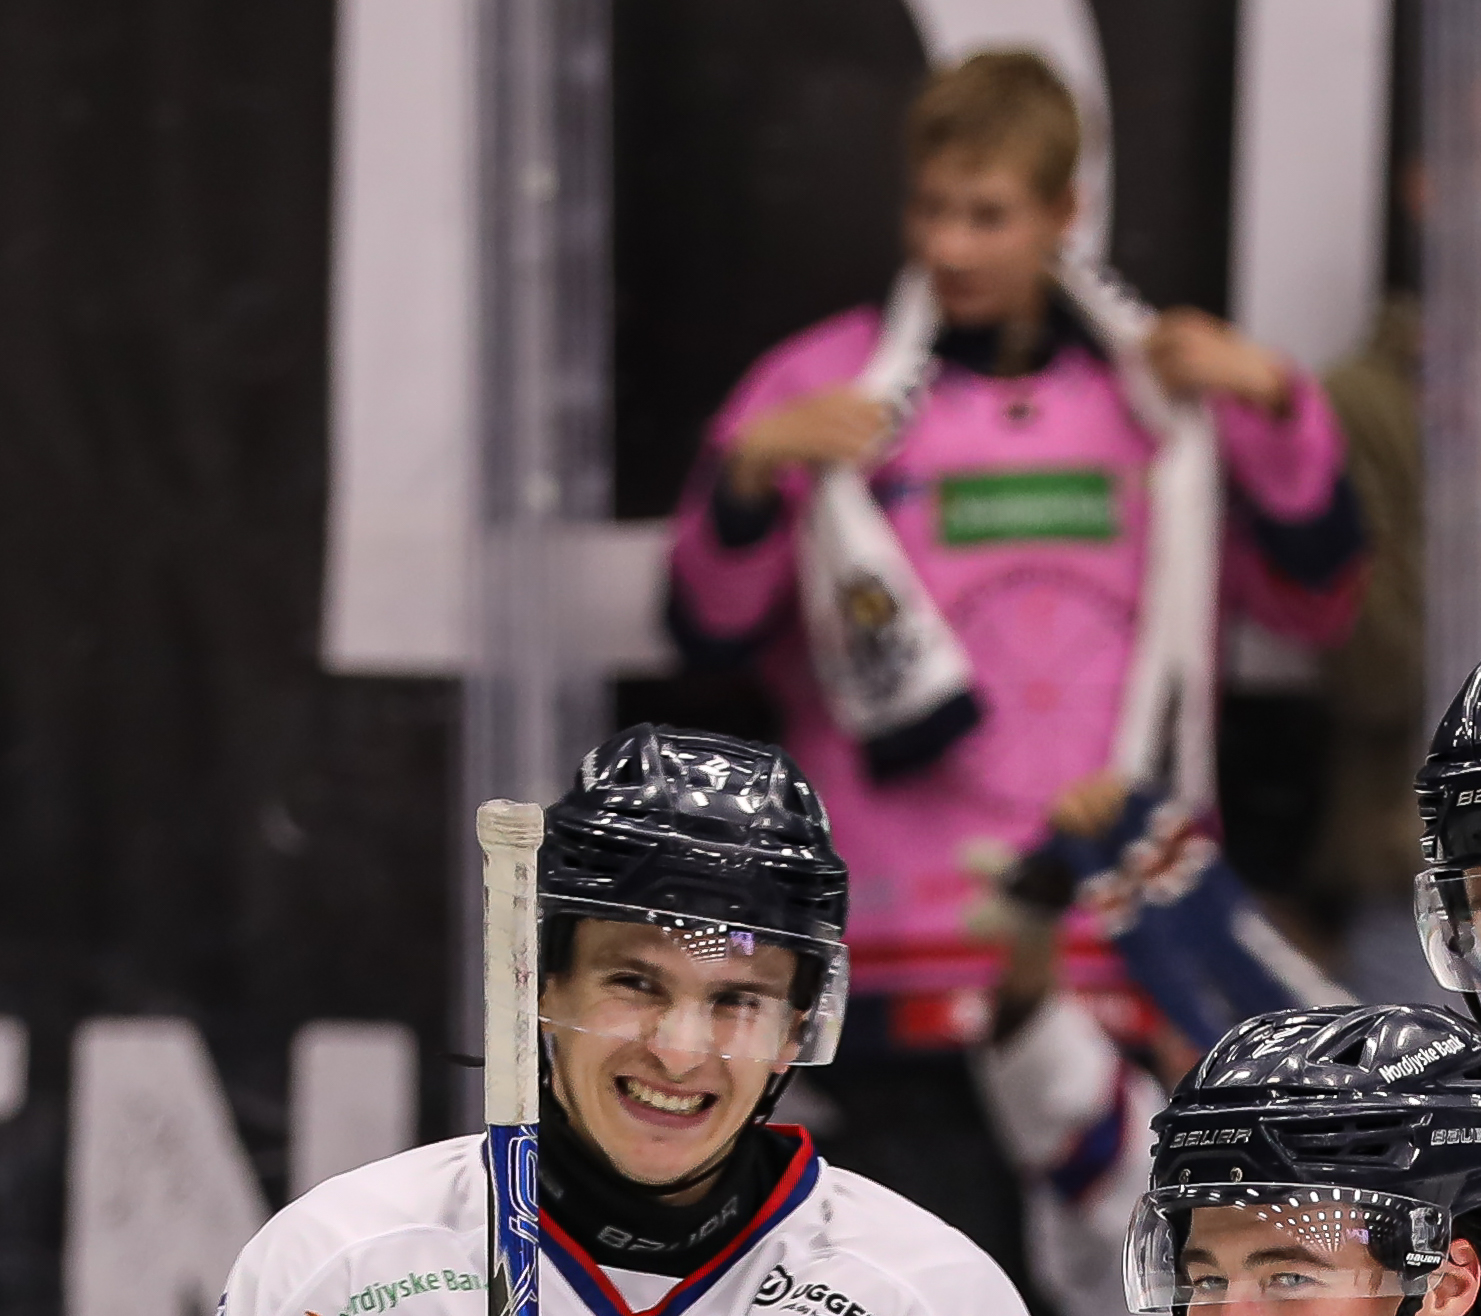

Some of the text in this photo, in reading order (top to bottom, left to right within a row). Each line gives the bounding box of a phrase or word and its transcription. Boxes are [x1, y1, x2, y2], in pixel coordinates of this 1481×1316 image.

[1379, 1034, 1467, 1085] Nordjyske Bank
[1170, 1128, 1253, 1150] BAUER
